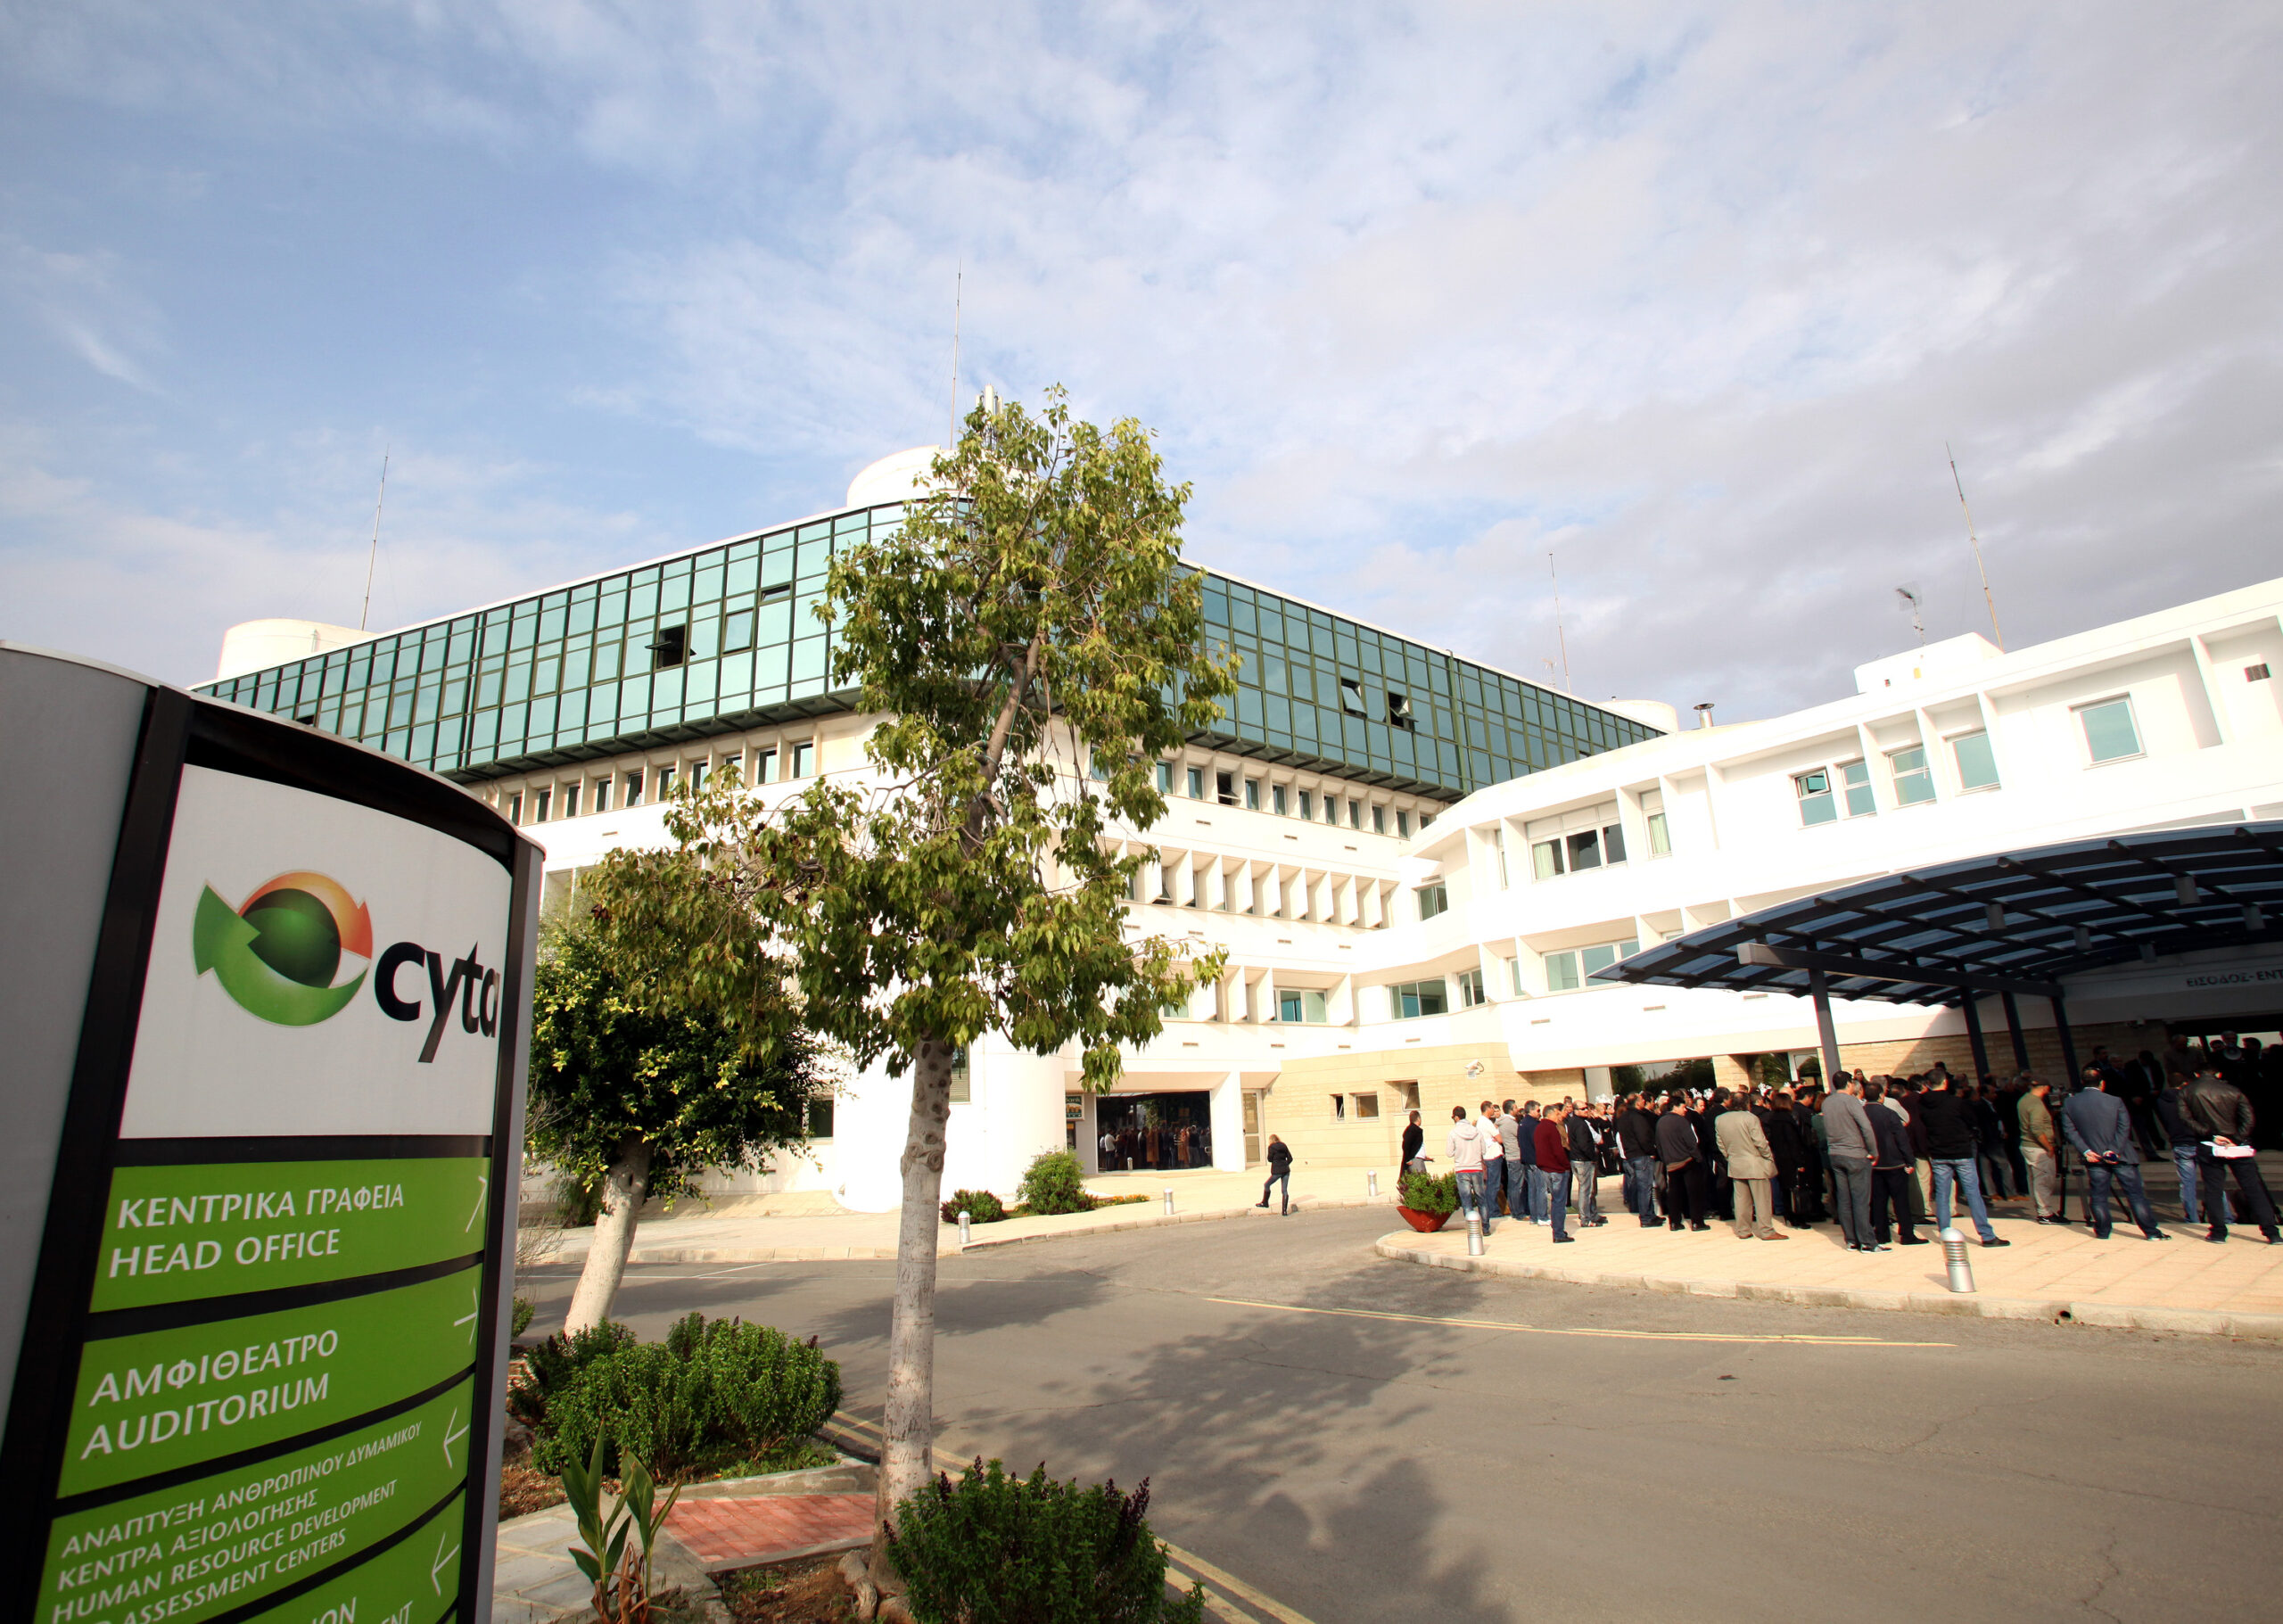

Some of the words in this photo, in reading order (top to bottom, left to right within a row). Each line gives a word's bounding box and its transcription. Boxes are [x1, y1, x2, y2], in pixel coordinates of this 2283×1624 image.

[374, 941, 500, 1063] cyta
[108, 1240, 222, 1278] HEAD
[235, 1229, 341, 1265] OFFICE
[117, 1191, 296, 1229] ΚΕΝΤΡΙΚΑ
[306, 1183, 404, 1215] ΓΡΑΦΕΙΑ
[88, 1329, 339, 1407] ΑΜΦΙΘΕΑΤΡΟ
[80, 1373, 329, 1460] AUDITORIUM
[52, 1570, 162, 1624] HUMAN
[170, 1528, 284, 1586] RESOURCE
[290, 1479, 398, 1542] DEVELOPMENT
[57, 1542, 163, 1592] ΚΕΝΤΡΑ
[169, 1488, 318, 1556] ΑΞΙΟΛΟΓΗΣΗΣ
[61, 1498, 205, 1558] ΑΝΑΠΤΥΞΗ
[210, 1453, 344, 1513] ΑΝΘΡΩΠΙΝΟΥ
[123, 1561, 271, 1624] ASSESSMENT
[275, 1528, 346, 1574] CENTERS
